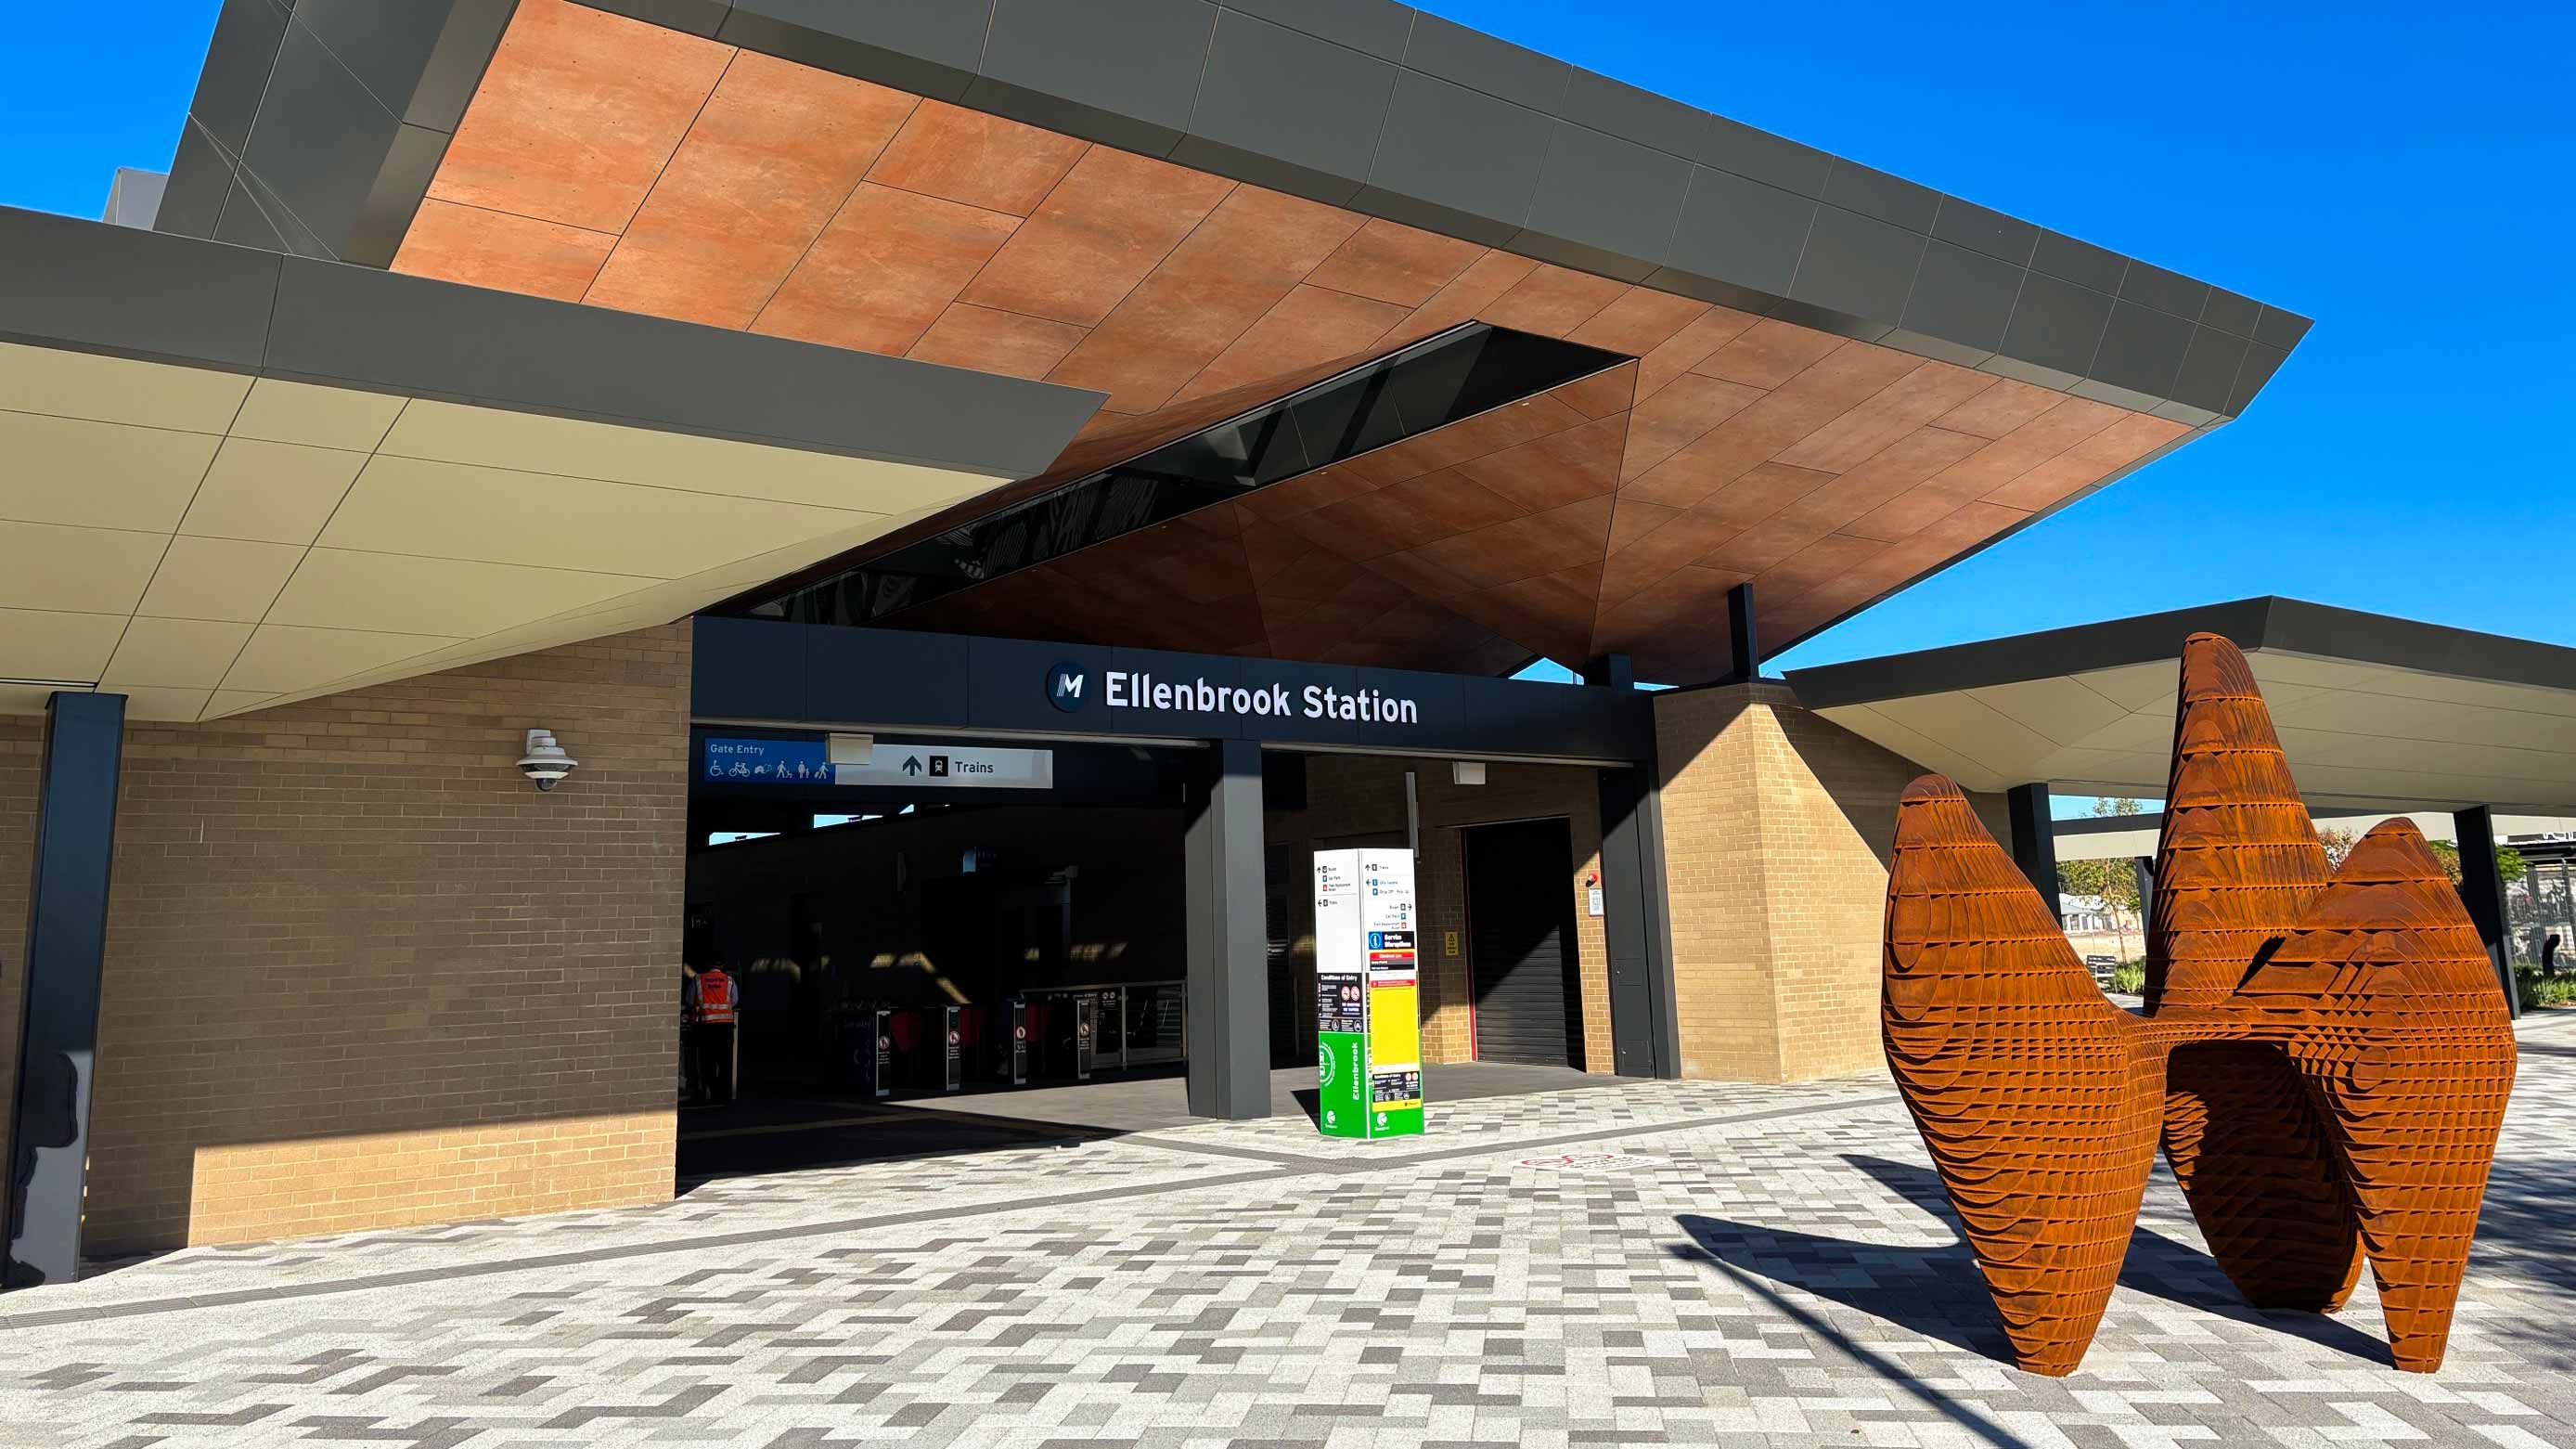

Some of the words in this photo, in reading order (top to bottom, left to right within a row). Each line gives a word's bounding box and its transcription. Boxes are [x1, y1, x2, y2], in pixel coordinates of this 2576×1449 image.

[1105, 670, 1292, 717] Ellenbrook
[1303, 685, 1418, 724] Station
[710, 744, 734, 754] Gate
[737, 744, 765, 757] Entry
[955, 761, 994, 774] Trains
[1351, 1041, 1359, 1101] Ellenbrook
